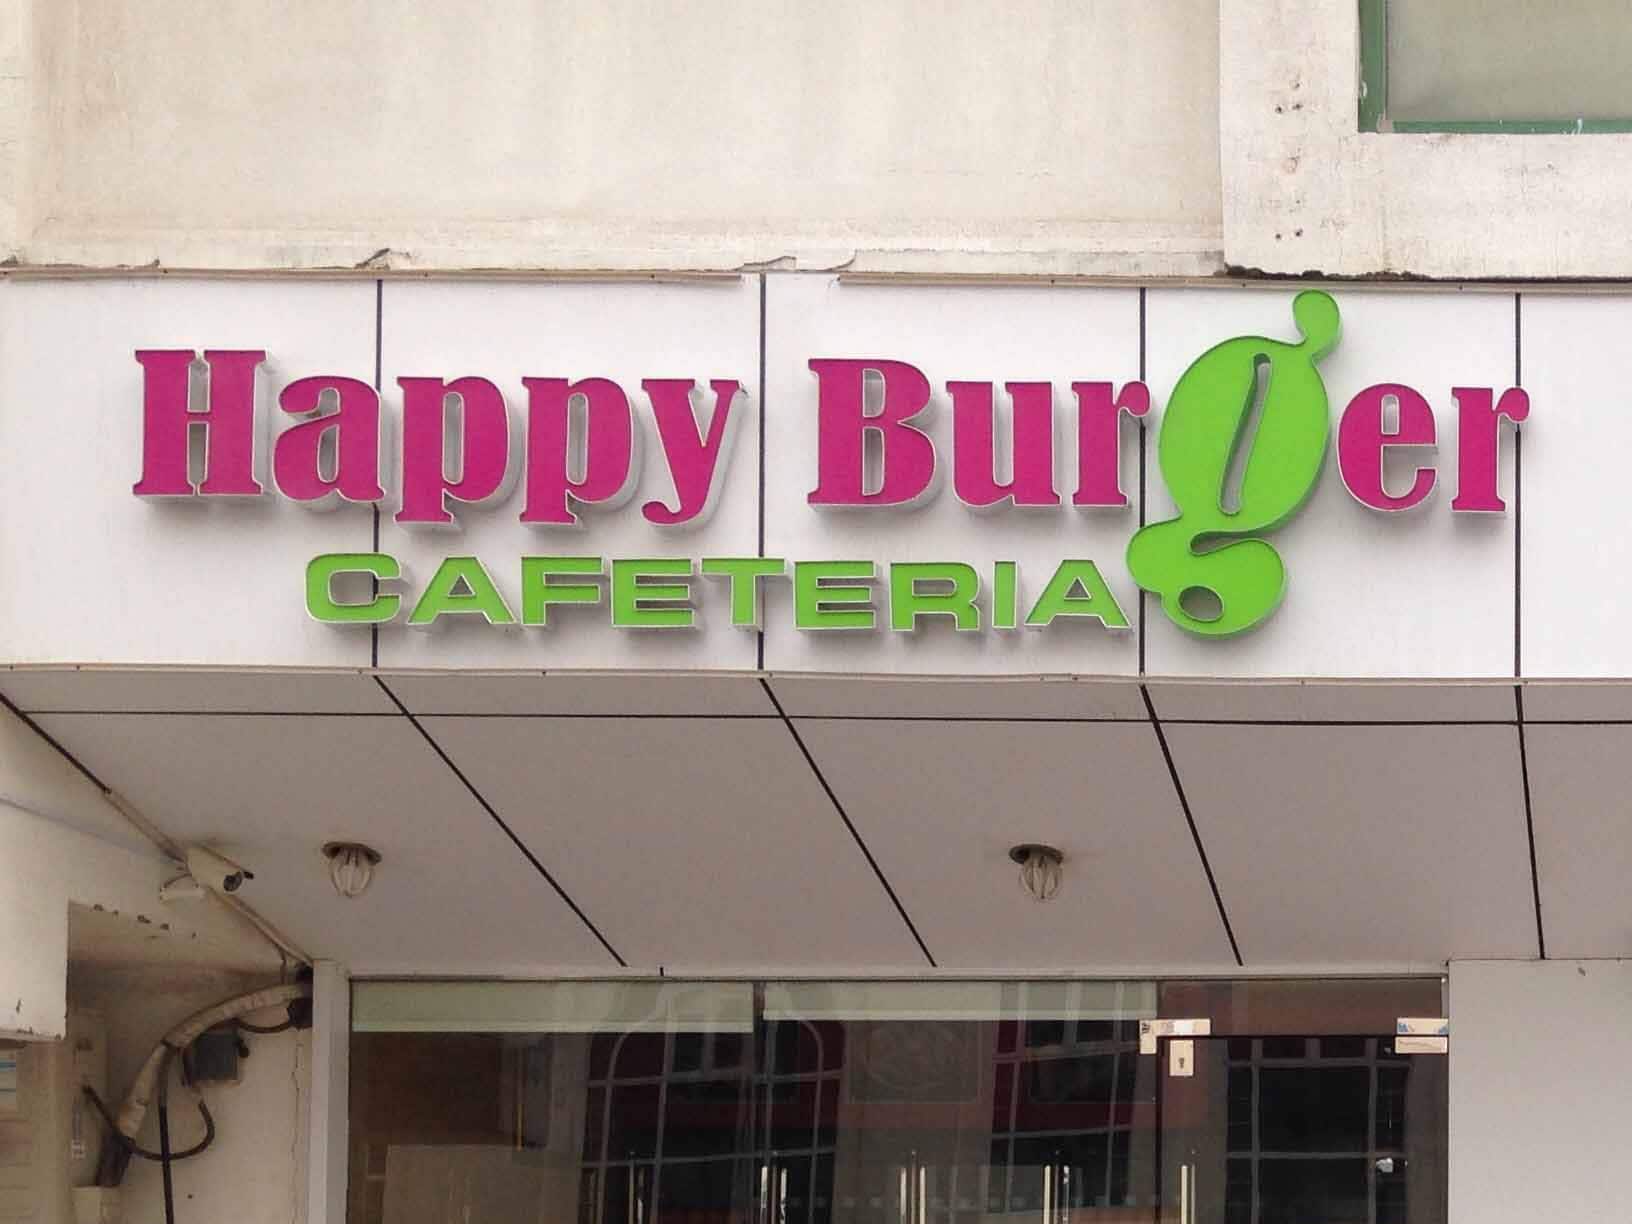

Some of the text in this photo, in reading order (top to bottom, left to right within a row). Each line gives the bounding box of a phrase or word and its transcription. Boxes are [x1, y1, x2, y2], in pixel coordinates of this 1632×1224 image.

[132, 287, 1531, 639] Happy Burger
[305, 553, 1130, 632] CAFETERIA
